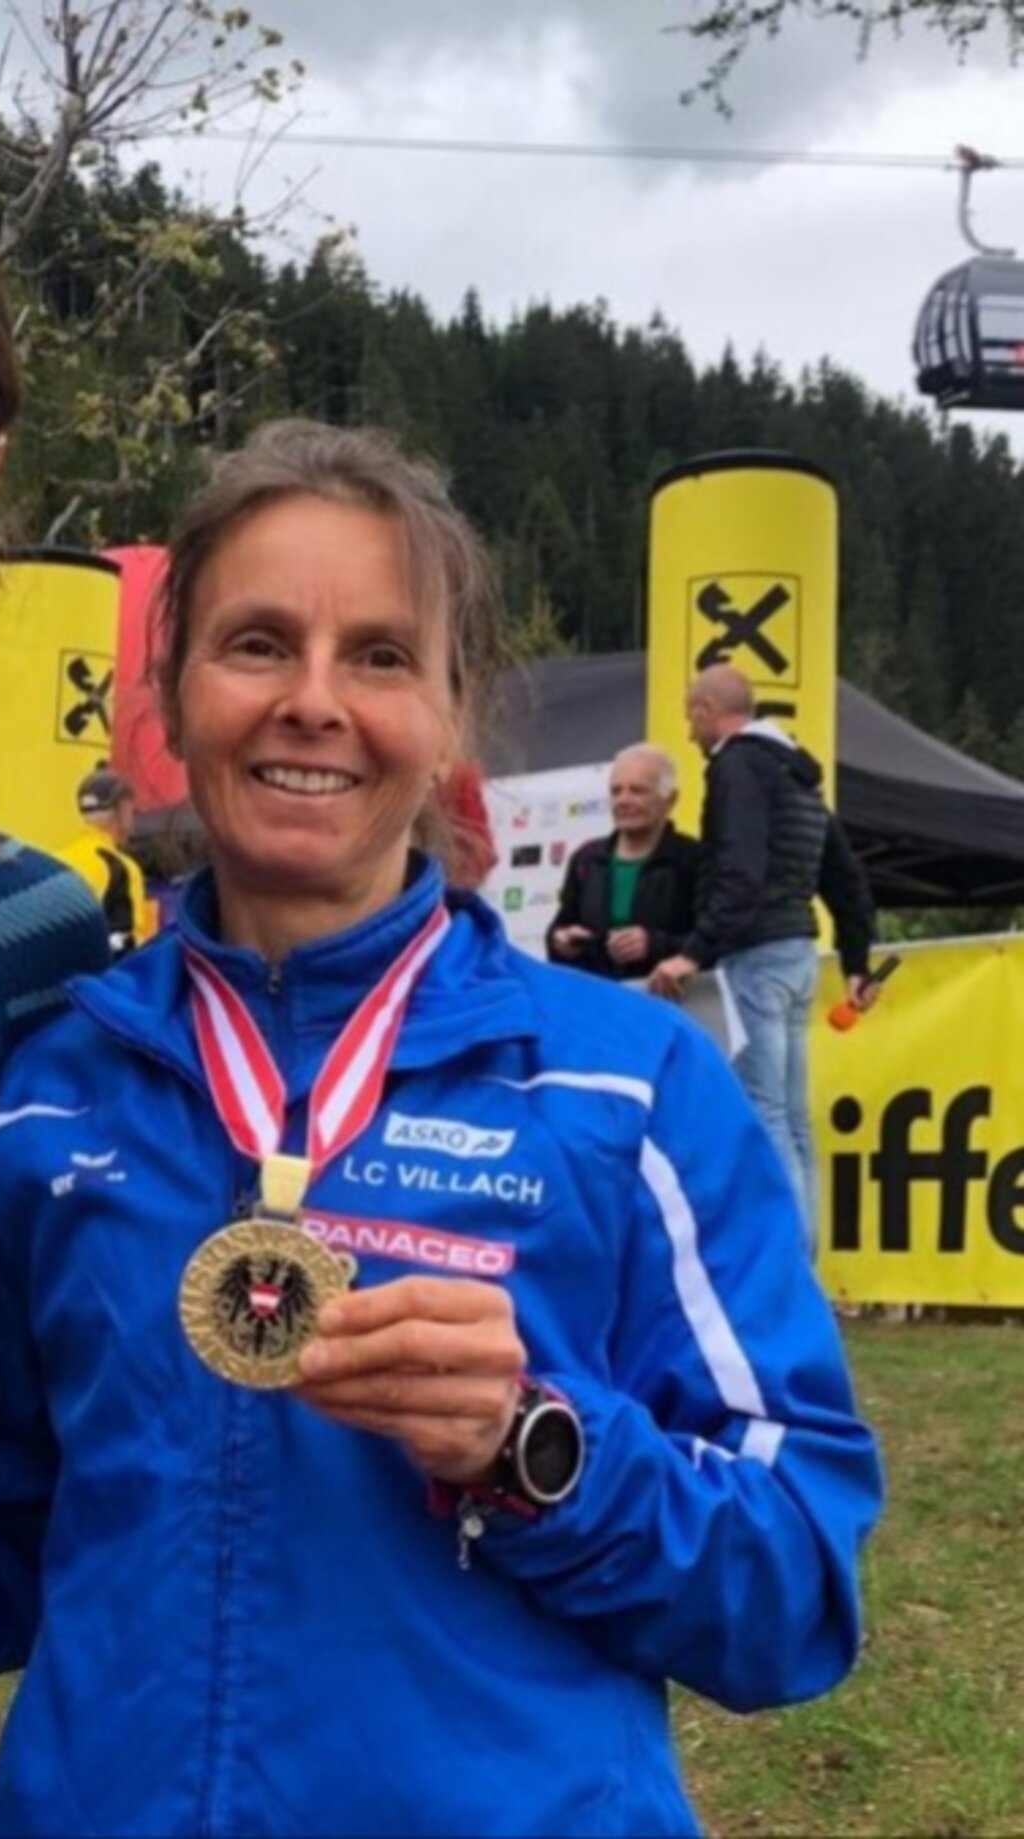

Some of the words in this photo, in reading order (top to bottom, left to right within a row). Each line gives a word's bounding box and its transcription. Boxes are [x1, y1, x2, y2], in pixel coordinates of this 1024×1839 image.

[342, 1155, 388, 1187] LC
[397, 1162, 544, 1206] VILLACH
[302, 1217, 509, 1275] PANACEO
